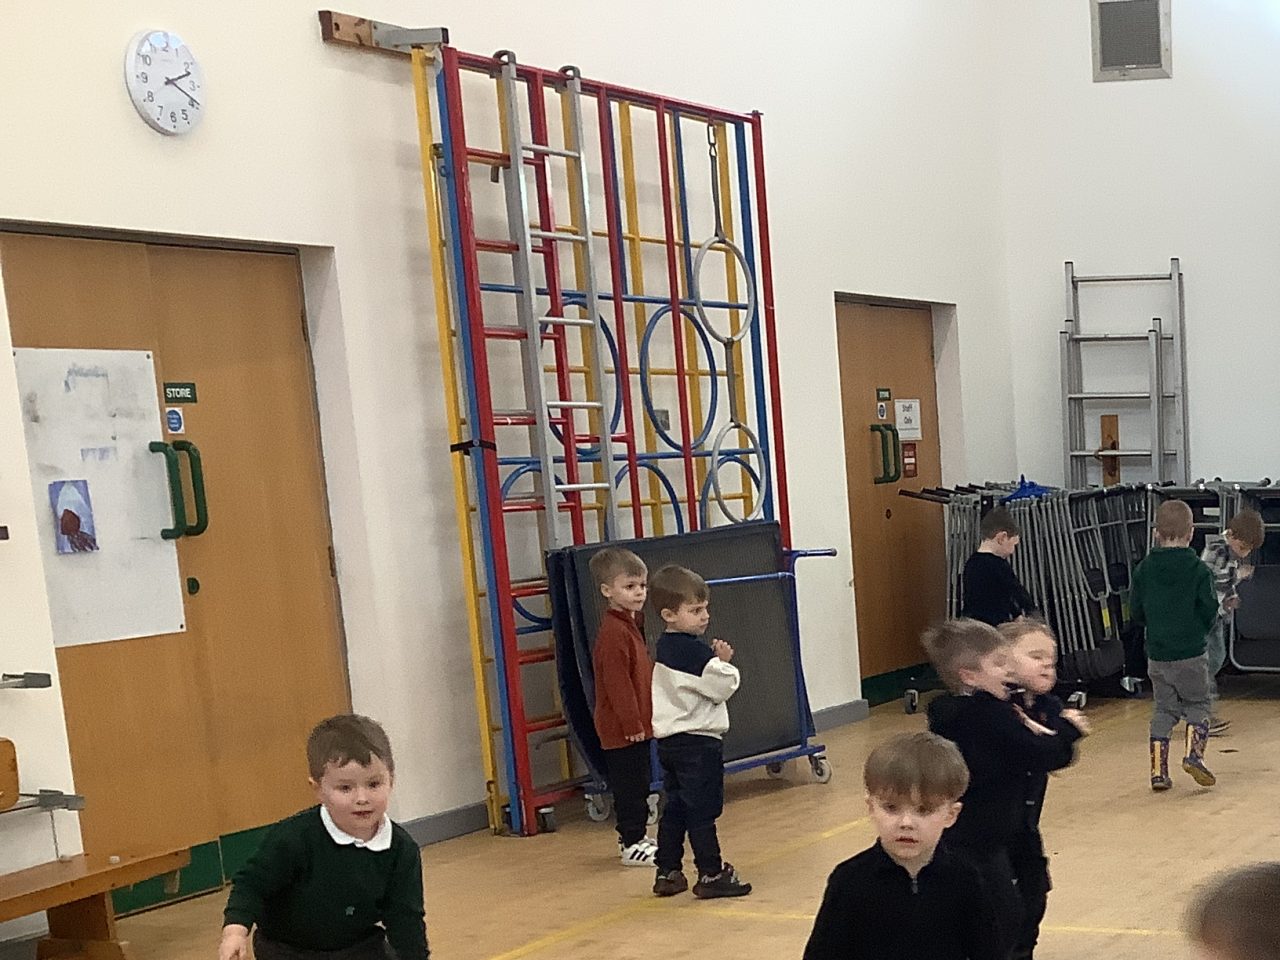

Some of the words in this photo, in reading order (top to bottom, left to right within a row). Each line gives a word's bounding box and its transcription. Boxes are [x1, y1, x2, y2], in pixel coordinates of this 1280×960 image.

[141, 54, 152, 66] 10
[140, 72, 148, 83] 9
[188, 80, 196, 91] 3
[146, 90, 154, 102] 8
[157, 105, 163, 116] 7
[180, 109, 188, 120] 5
[169, 111, 177, 123] 6
[166, 388, 191, 398] STORE
